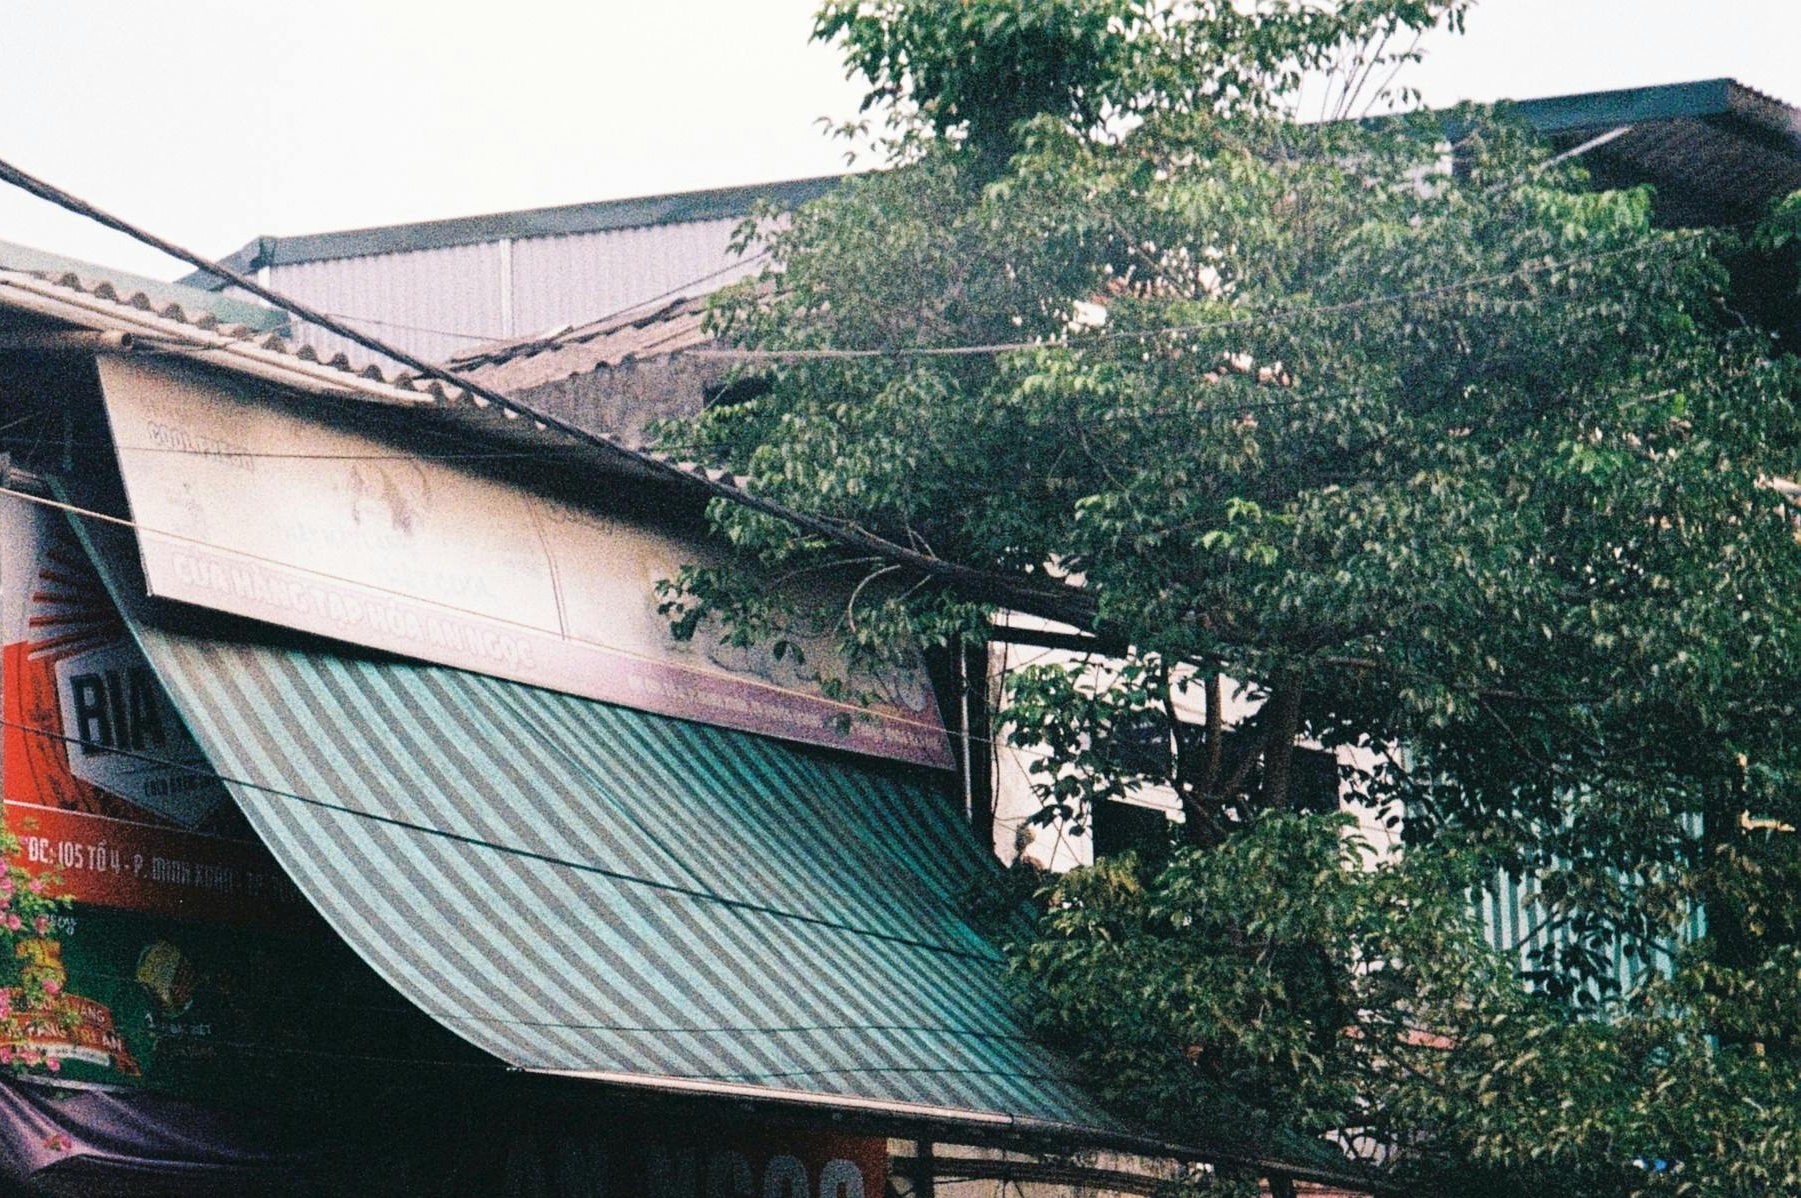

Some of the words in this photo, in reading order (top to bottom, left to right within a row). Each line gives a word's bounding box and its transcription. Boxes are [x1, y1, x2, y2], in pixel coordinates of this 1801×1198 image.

[58, 840, 83, 869] 105
[87, 839, 107, 871] TỔ
[110, 849, 120, 874] 4
